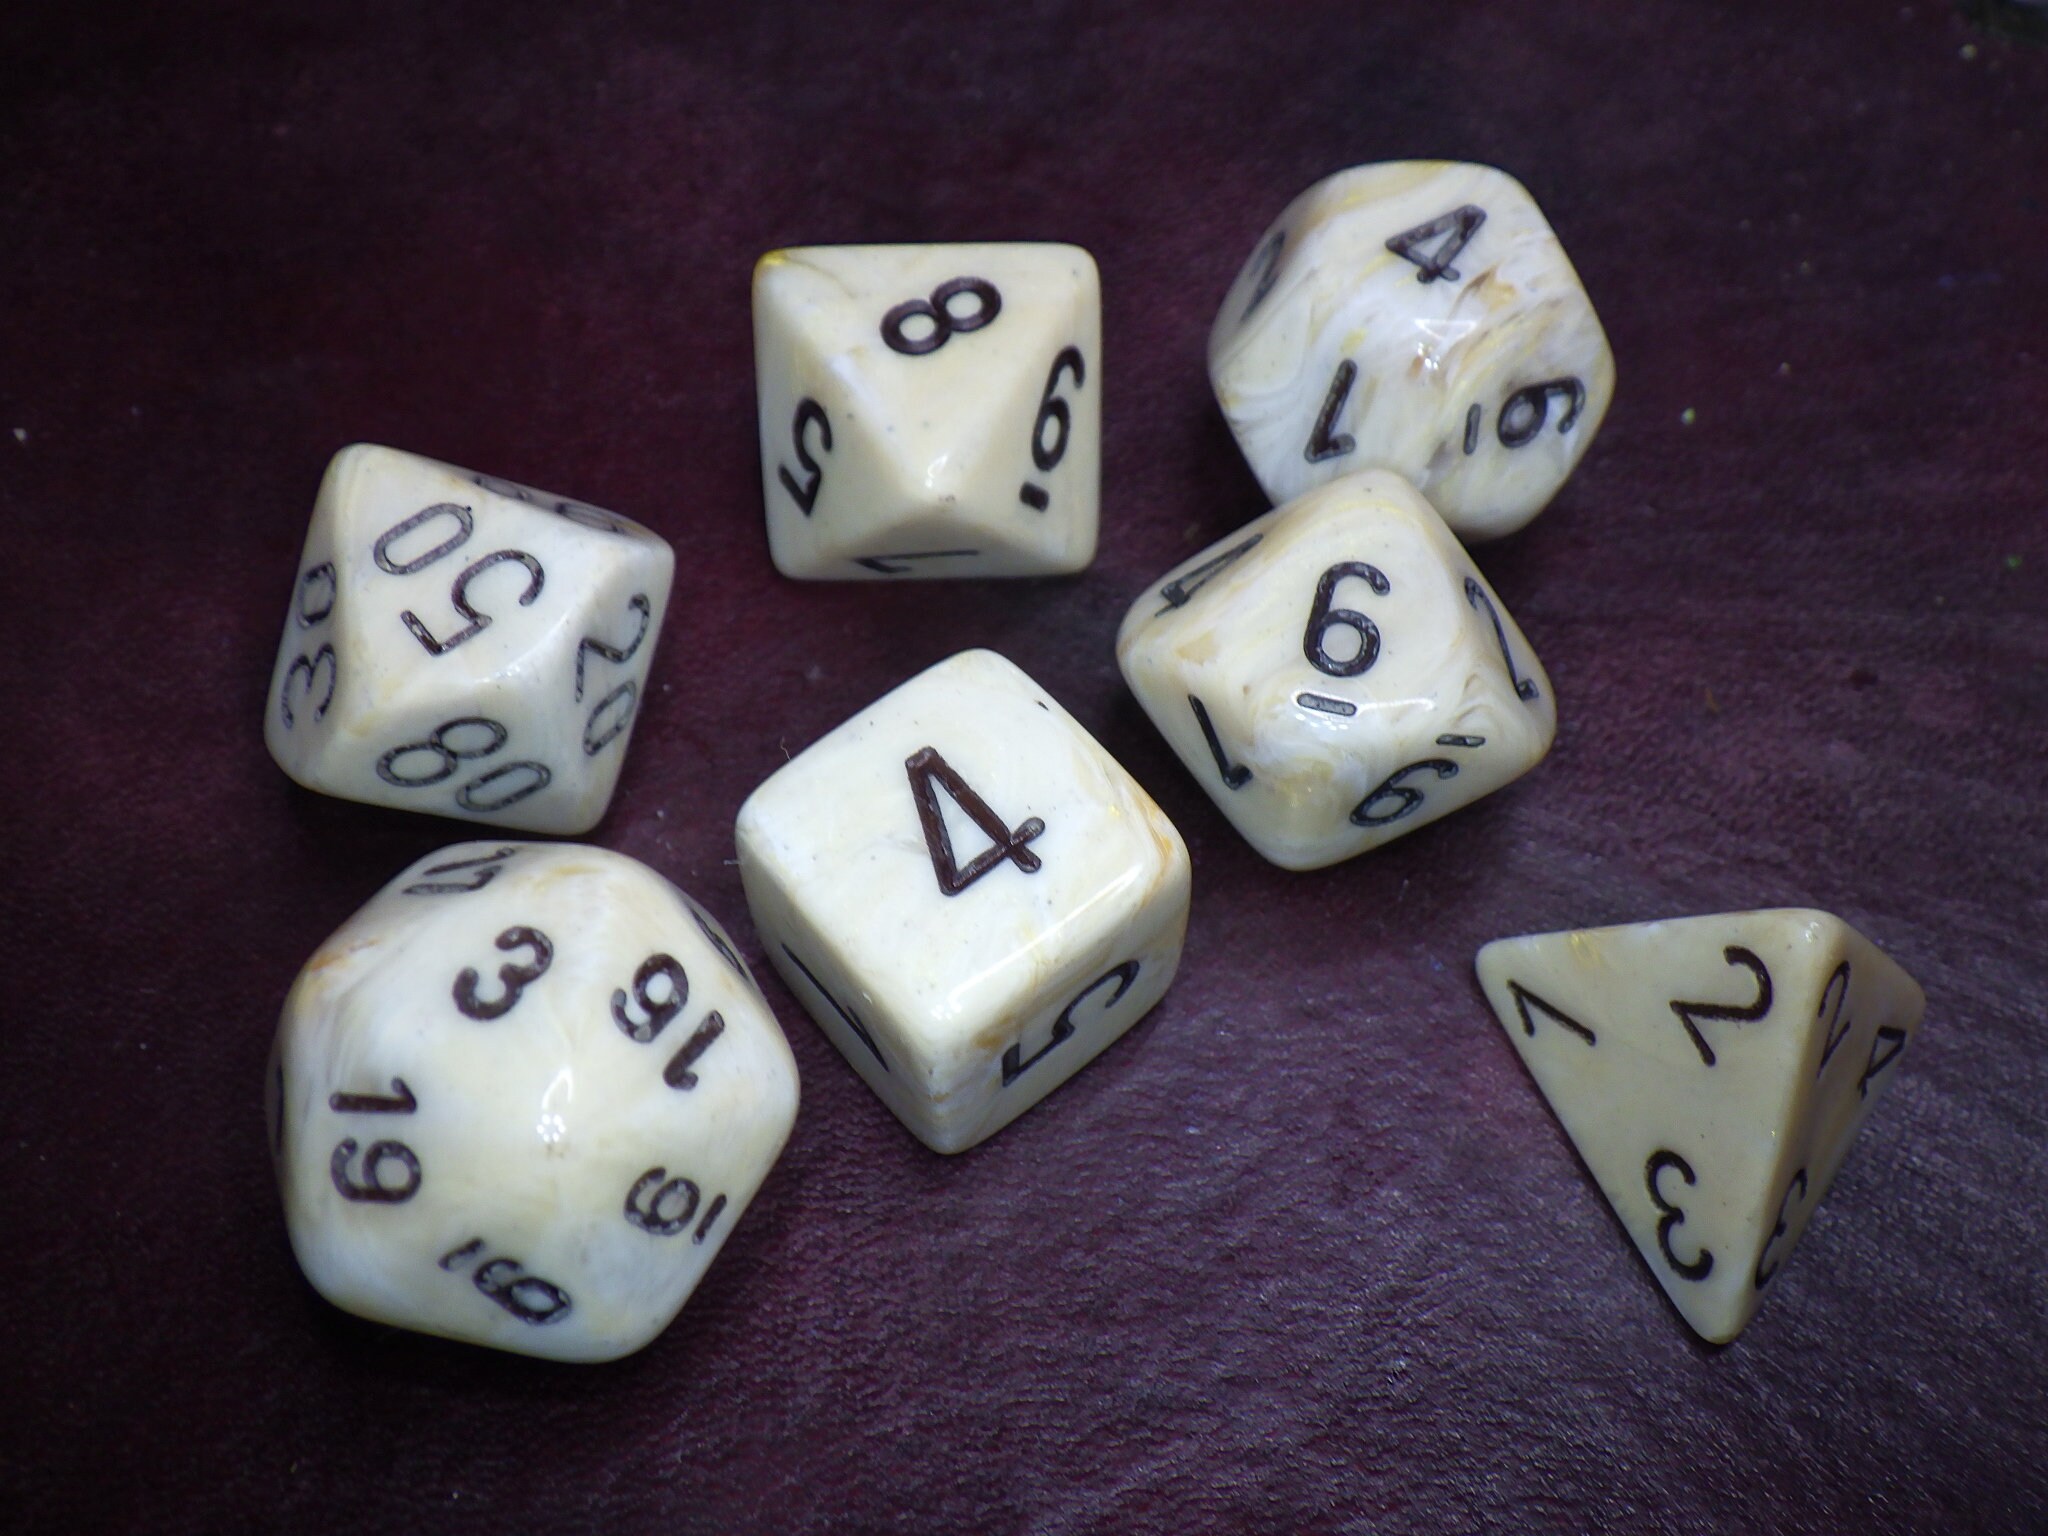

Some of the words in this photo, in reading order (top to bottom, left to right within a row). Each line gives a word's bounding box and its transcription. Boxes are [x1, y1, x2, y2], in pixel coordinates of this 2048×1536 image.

[1385, 204, 1487, 284] 4
[880, 276, 1001, 355] 8
[778, 396, 833, 517] 5
[373, 502, 545, 656] 50
[1155, 533, 1263, 617] 4
[281, 561, 337, 729] 30
[576, 594, 650, 756] 20
[376, 717, 551, 812] 80
[905, 746, 1045, 896] 4
[452, 926, 554, 1021] 3
[610, 953, 726, 1091] 16
[1003, 960, 1140, 1087] 5
[1669, 945, 1773, 1067] 2
[1817, 960, 1851, 1080] 2
[1857, 1024, 1907, 1099] 4
[329, 1077, 422, 1204] 19
[1645, 1149, 1714, 1283] 3
[1755, 1168, 1808, 1292] 3
